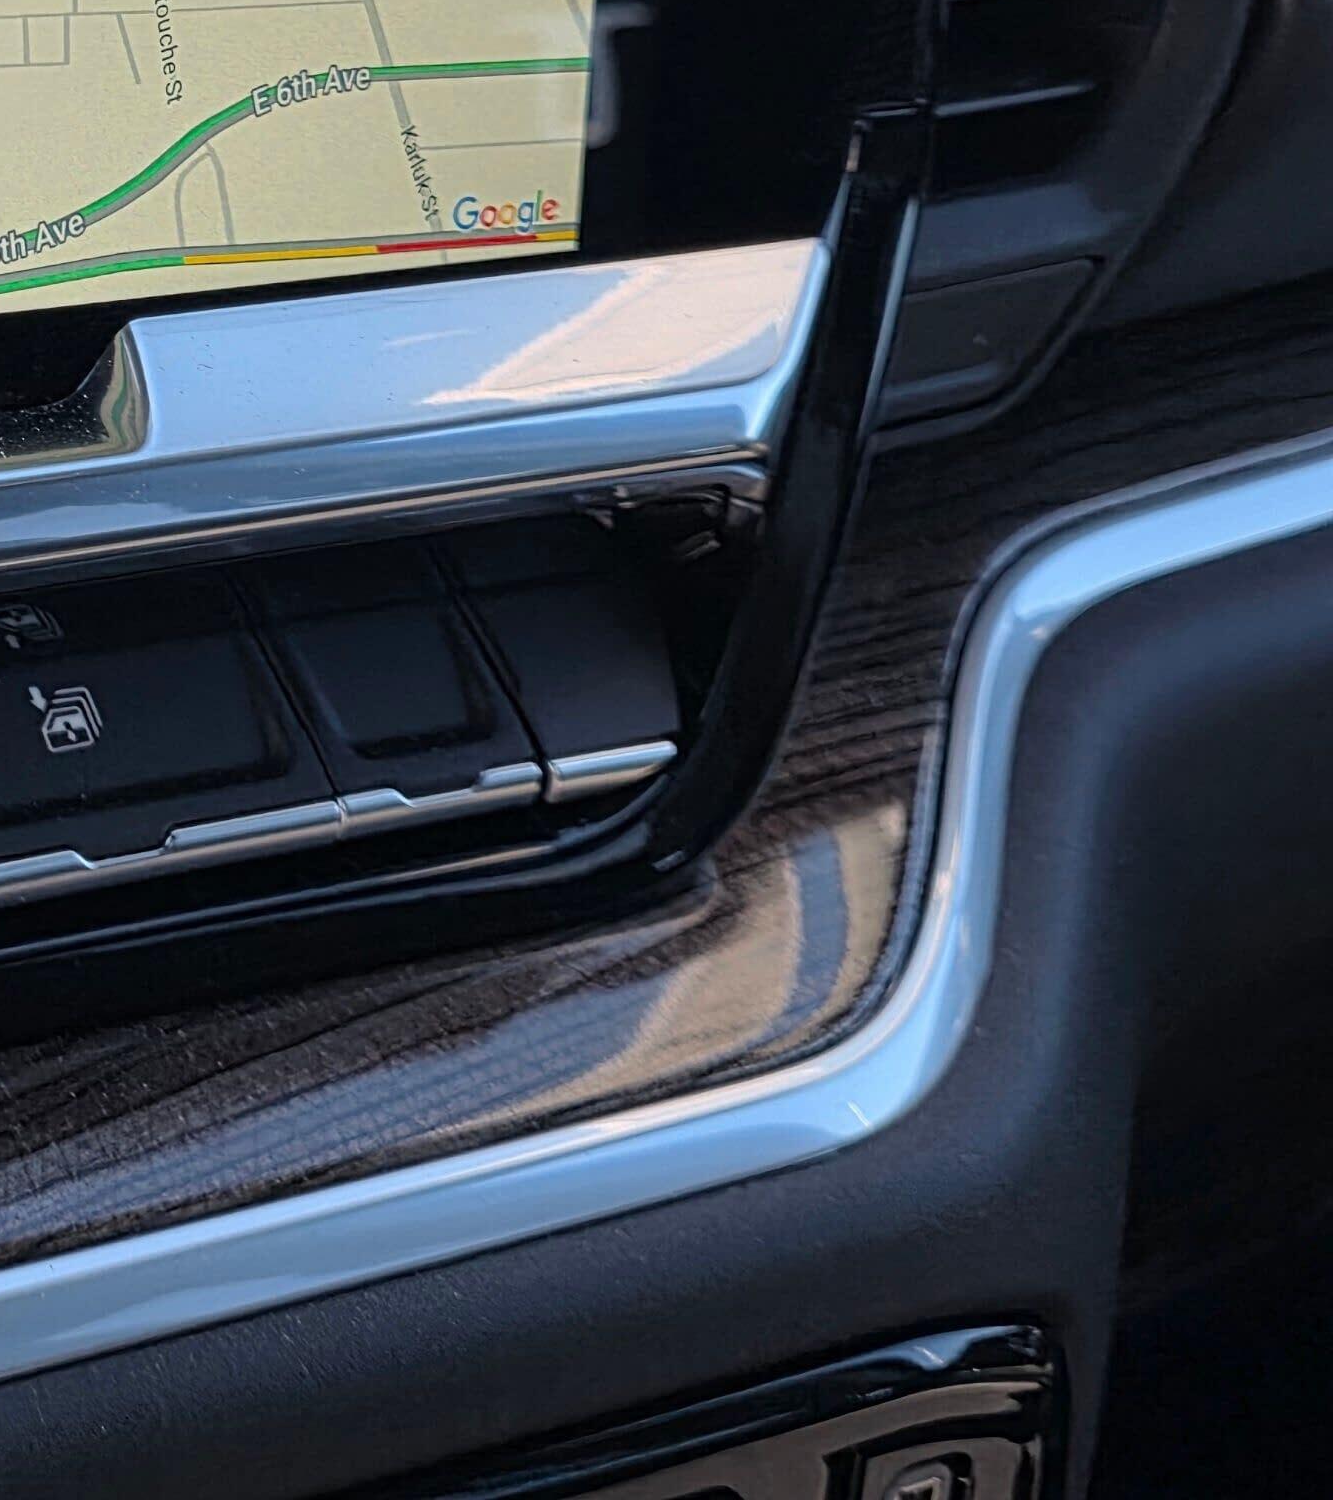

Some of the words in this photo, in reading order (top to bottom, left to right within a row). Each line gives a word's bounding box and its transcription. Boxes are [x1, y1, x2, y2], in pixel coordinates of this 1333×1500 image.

[163, 76, 183, 106] St
[251, 87, 272, 117] E
[274, 74, 317, 109] 6th
[321, 64, 371, 96] Ave
[399, 124, 433, 194] Karluk
[419, 191, 439, 221] St
[453, 189, 561, 231] Google
[31, 211, 86, 254] Ave
